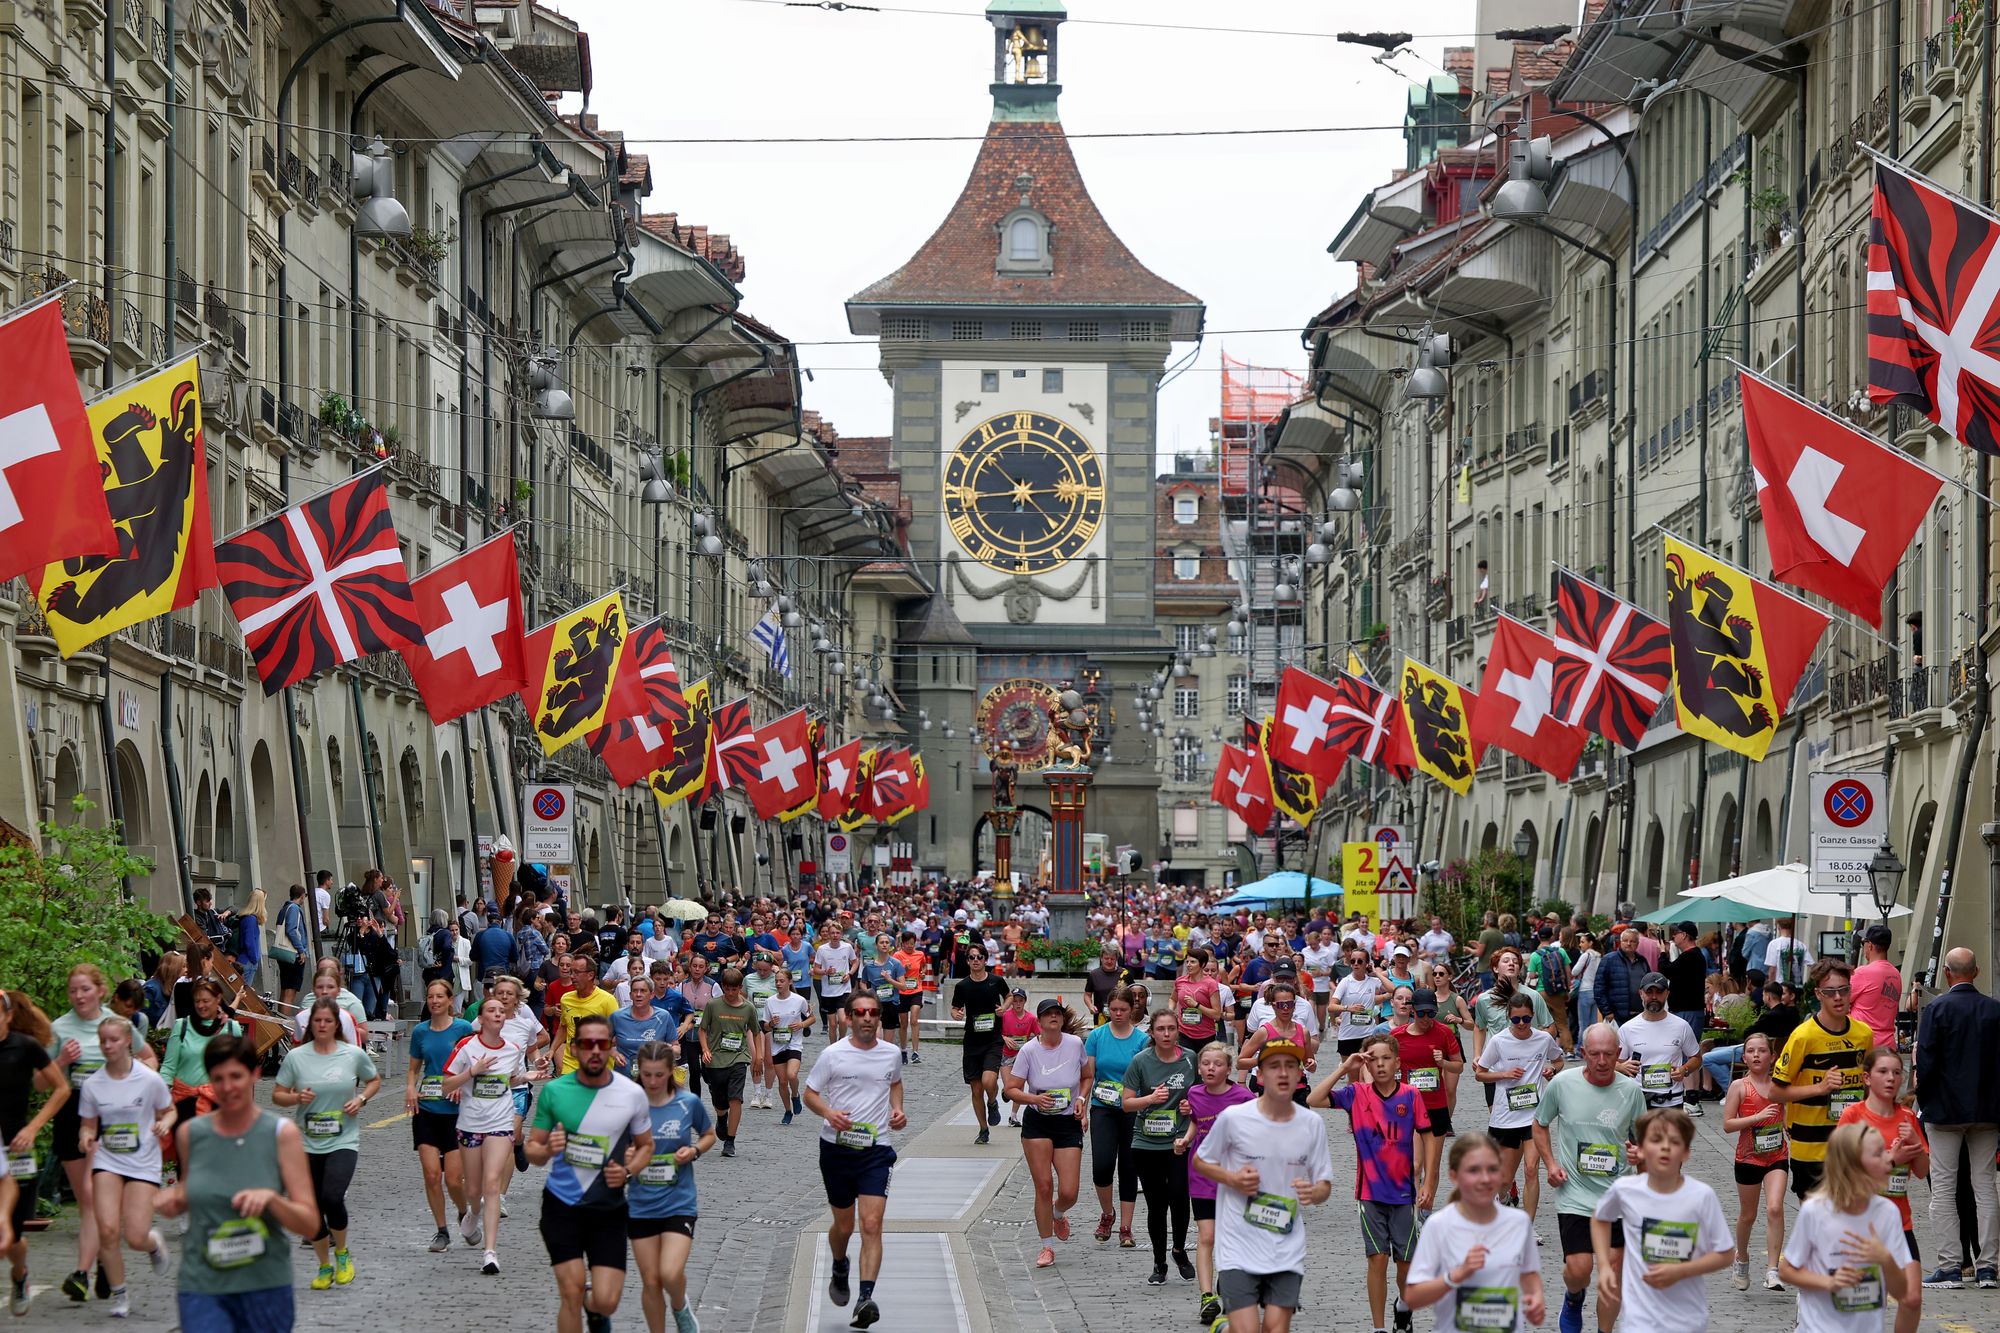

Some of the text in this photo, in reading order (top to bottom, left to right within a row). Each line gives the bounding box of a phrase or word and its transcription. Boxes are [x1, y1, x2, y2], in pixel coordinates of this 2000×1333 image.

[1819, 836, 1877, 844] Ganze Gasse
[1358, 847, 1373, 873] 2
[1828, 862, 1868, 871] 18.05.24
[1835, 874, 1862, 883] 12.00
[1372, 1120, 1398, 1140] All
[842, 1131, 871, 1141] Raphael
[1588, 1155, 1608, 1164] Peter
[1261, 1207, 1281, 1218] Fred
[1660, 1238, 1679, 1248] Nils
[1472, 1305, 1507, 1315] Noemi
